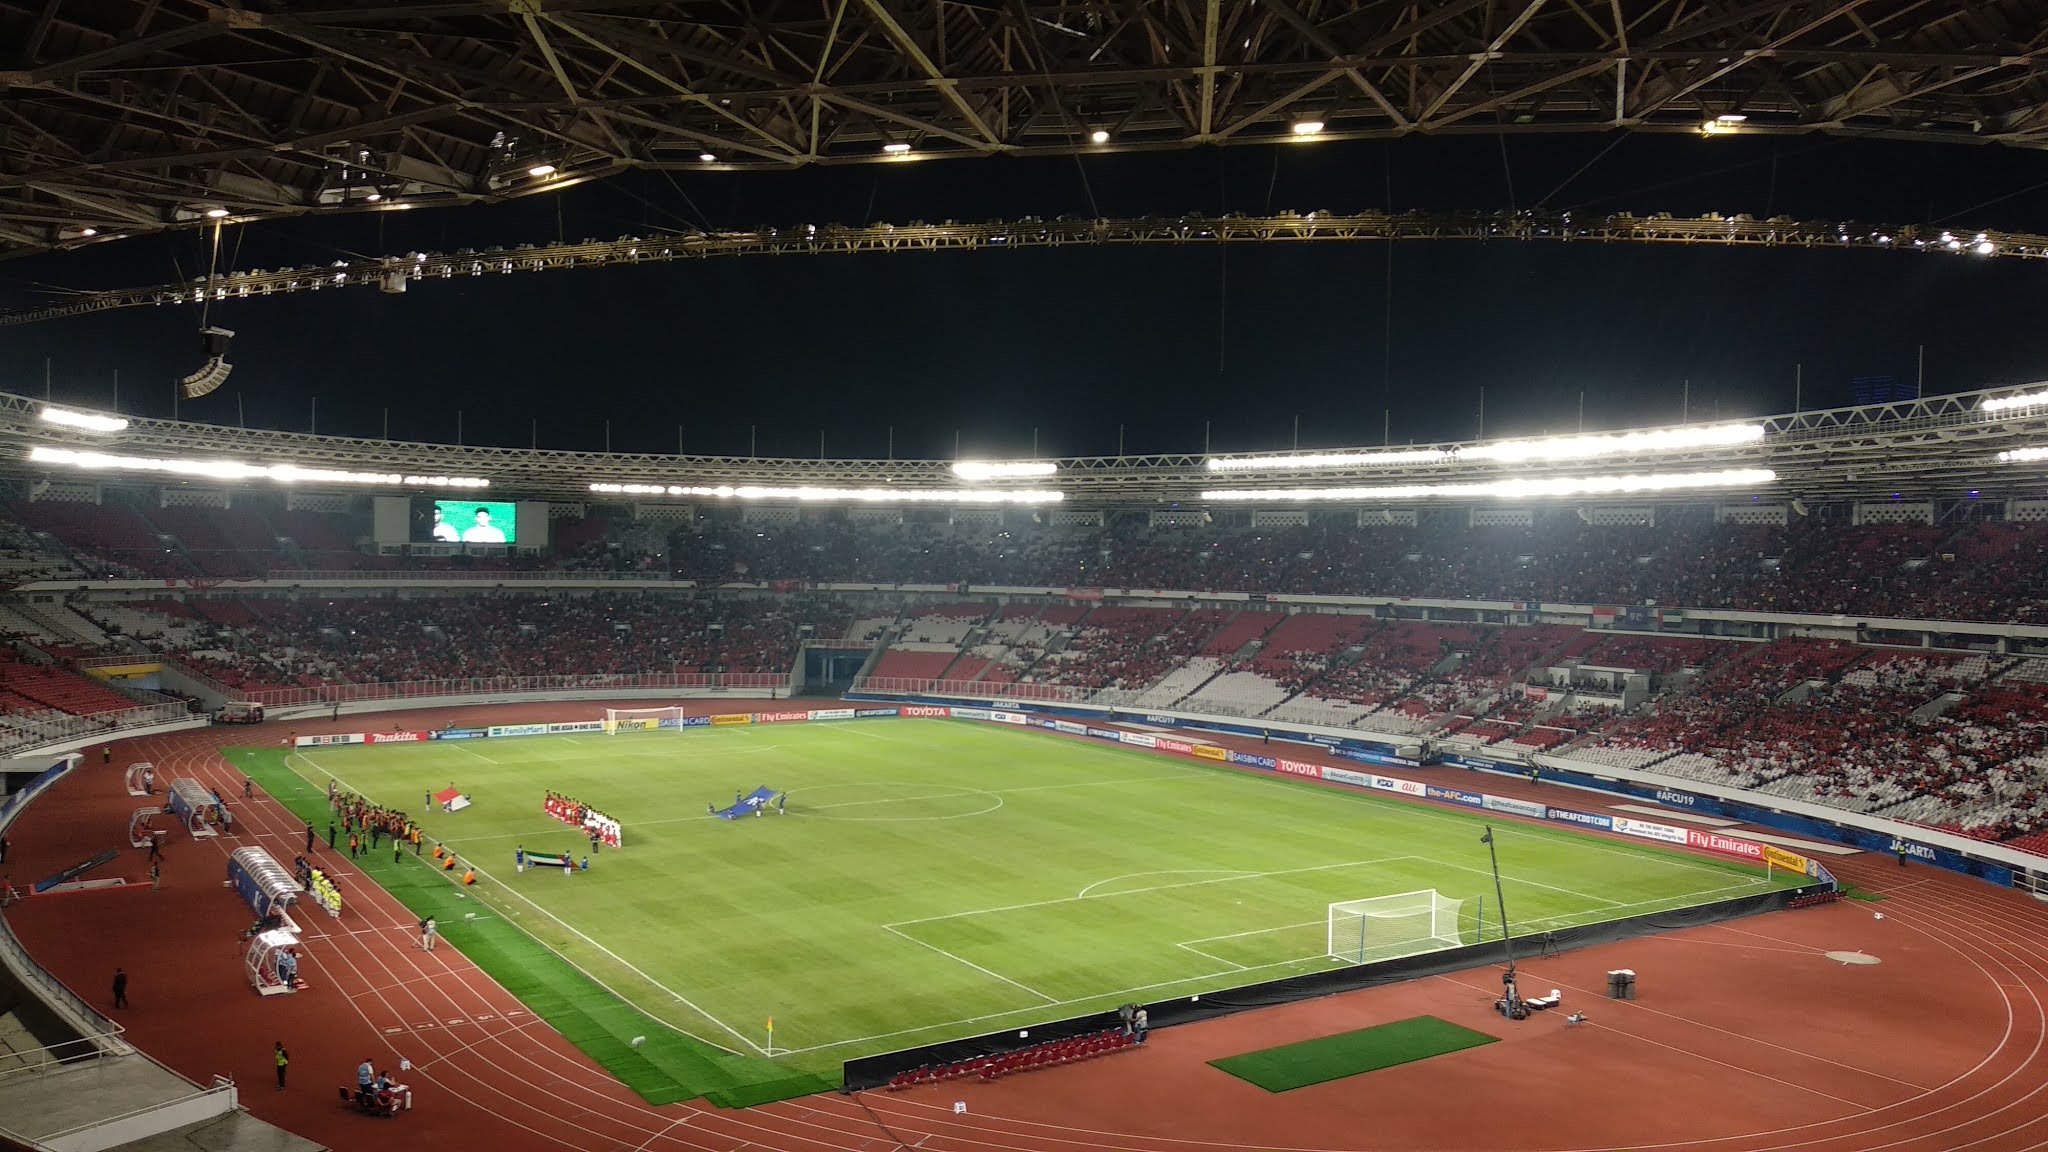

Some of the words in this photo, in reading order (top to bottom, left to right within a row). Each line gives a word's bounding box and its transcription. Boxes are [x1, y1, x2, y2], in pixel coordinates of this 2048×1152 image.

[992, 701, 1020, 709] JAKARTA
[761, 712, 774, 721] Fly
[775, 712, 806, 720] Emirates
[906, 707, 946, 716] TOYOTA
[617, 720, 647, 730] Nikon
[689, 716, 710, 725] CARD
[1146, 715, 1176, 724] #AFCU19
[504, 727, 545, 736] FamilyMart
[1167, 740, 1193, 753] Emirates
[1257, 757, 1277, 768] CARD
[1280, 759, 1318, 776] TOYOTA
[1427, 786, 1482, 805] the-AFC.com
[1656, 790, 1695, 806] #AFCU19
[1548, 809, 1611, 827] @THEAFCDOTCOM
[1690, 831, 1709, 848] Fly
[1710, 835, 1761, 856] Emirates
[1764, 846, 1799, 866] Continental
